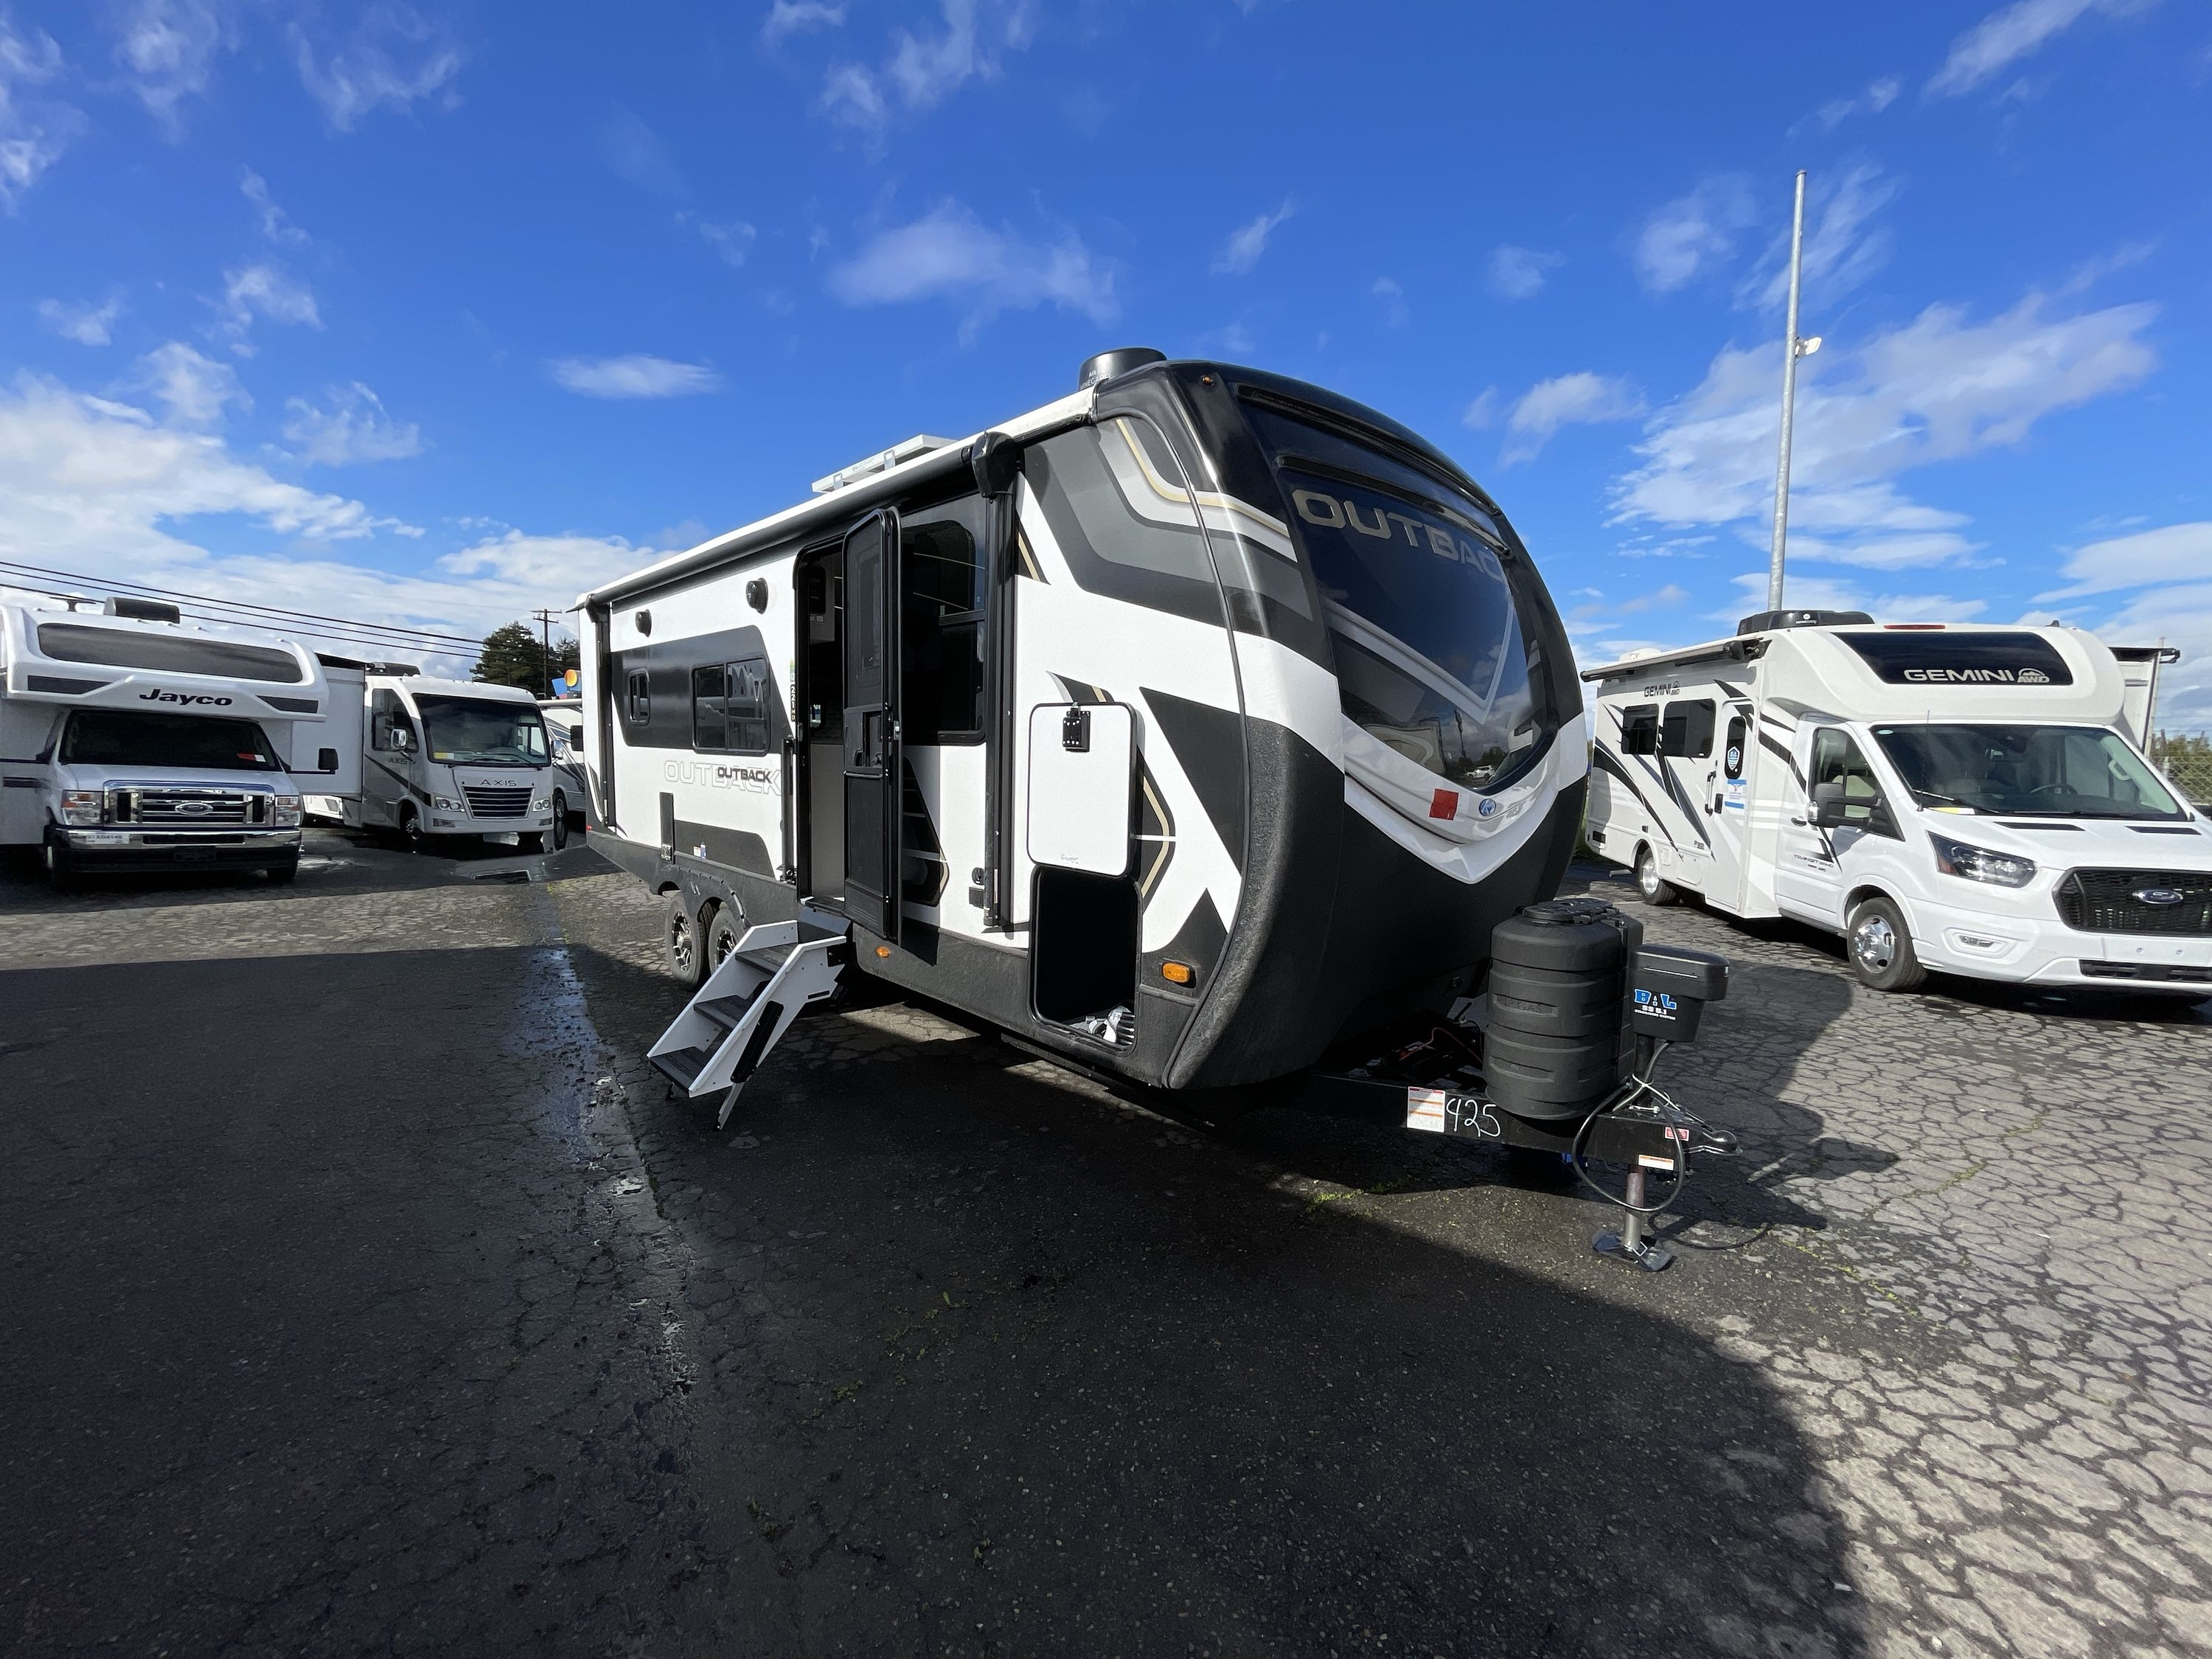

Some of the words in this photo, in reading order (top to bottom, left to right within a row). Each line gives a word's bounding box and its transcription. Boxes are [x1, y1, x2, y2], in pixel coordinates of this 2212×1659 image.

[1292, 489, 1505, 584] OUTBAC
[1903, 669, 2015, 681] GEMINI
[2017, 675, 2050, 684] AWD
[139, 689, 233, 706] Jayco
[1644, 684, 1672, 697] GEMINI
[664, 760, 782, 796] OUTBACK
[717, 767, 773, 784] OUTBACK
[1446, 1098, 1501, 1137] 425
